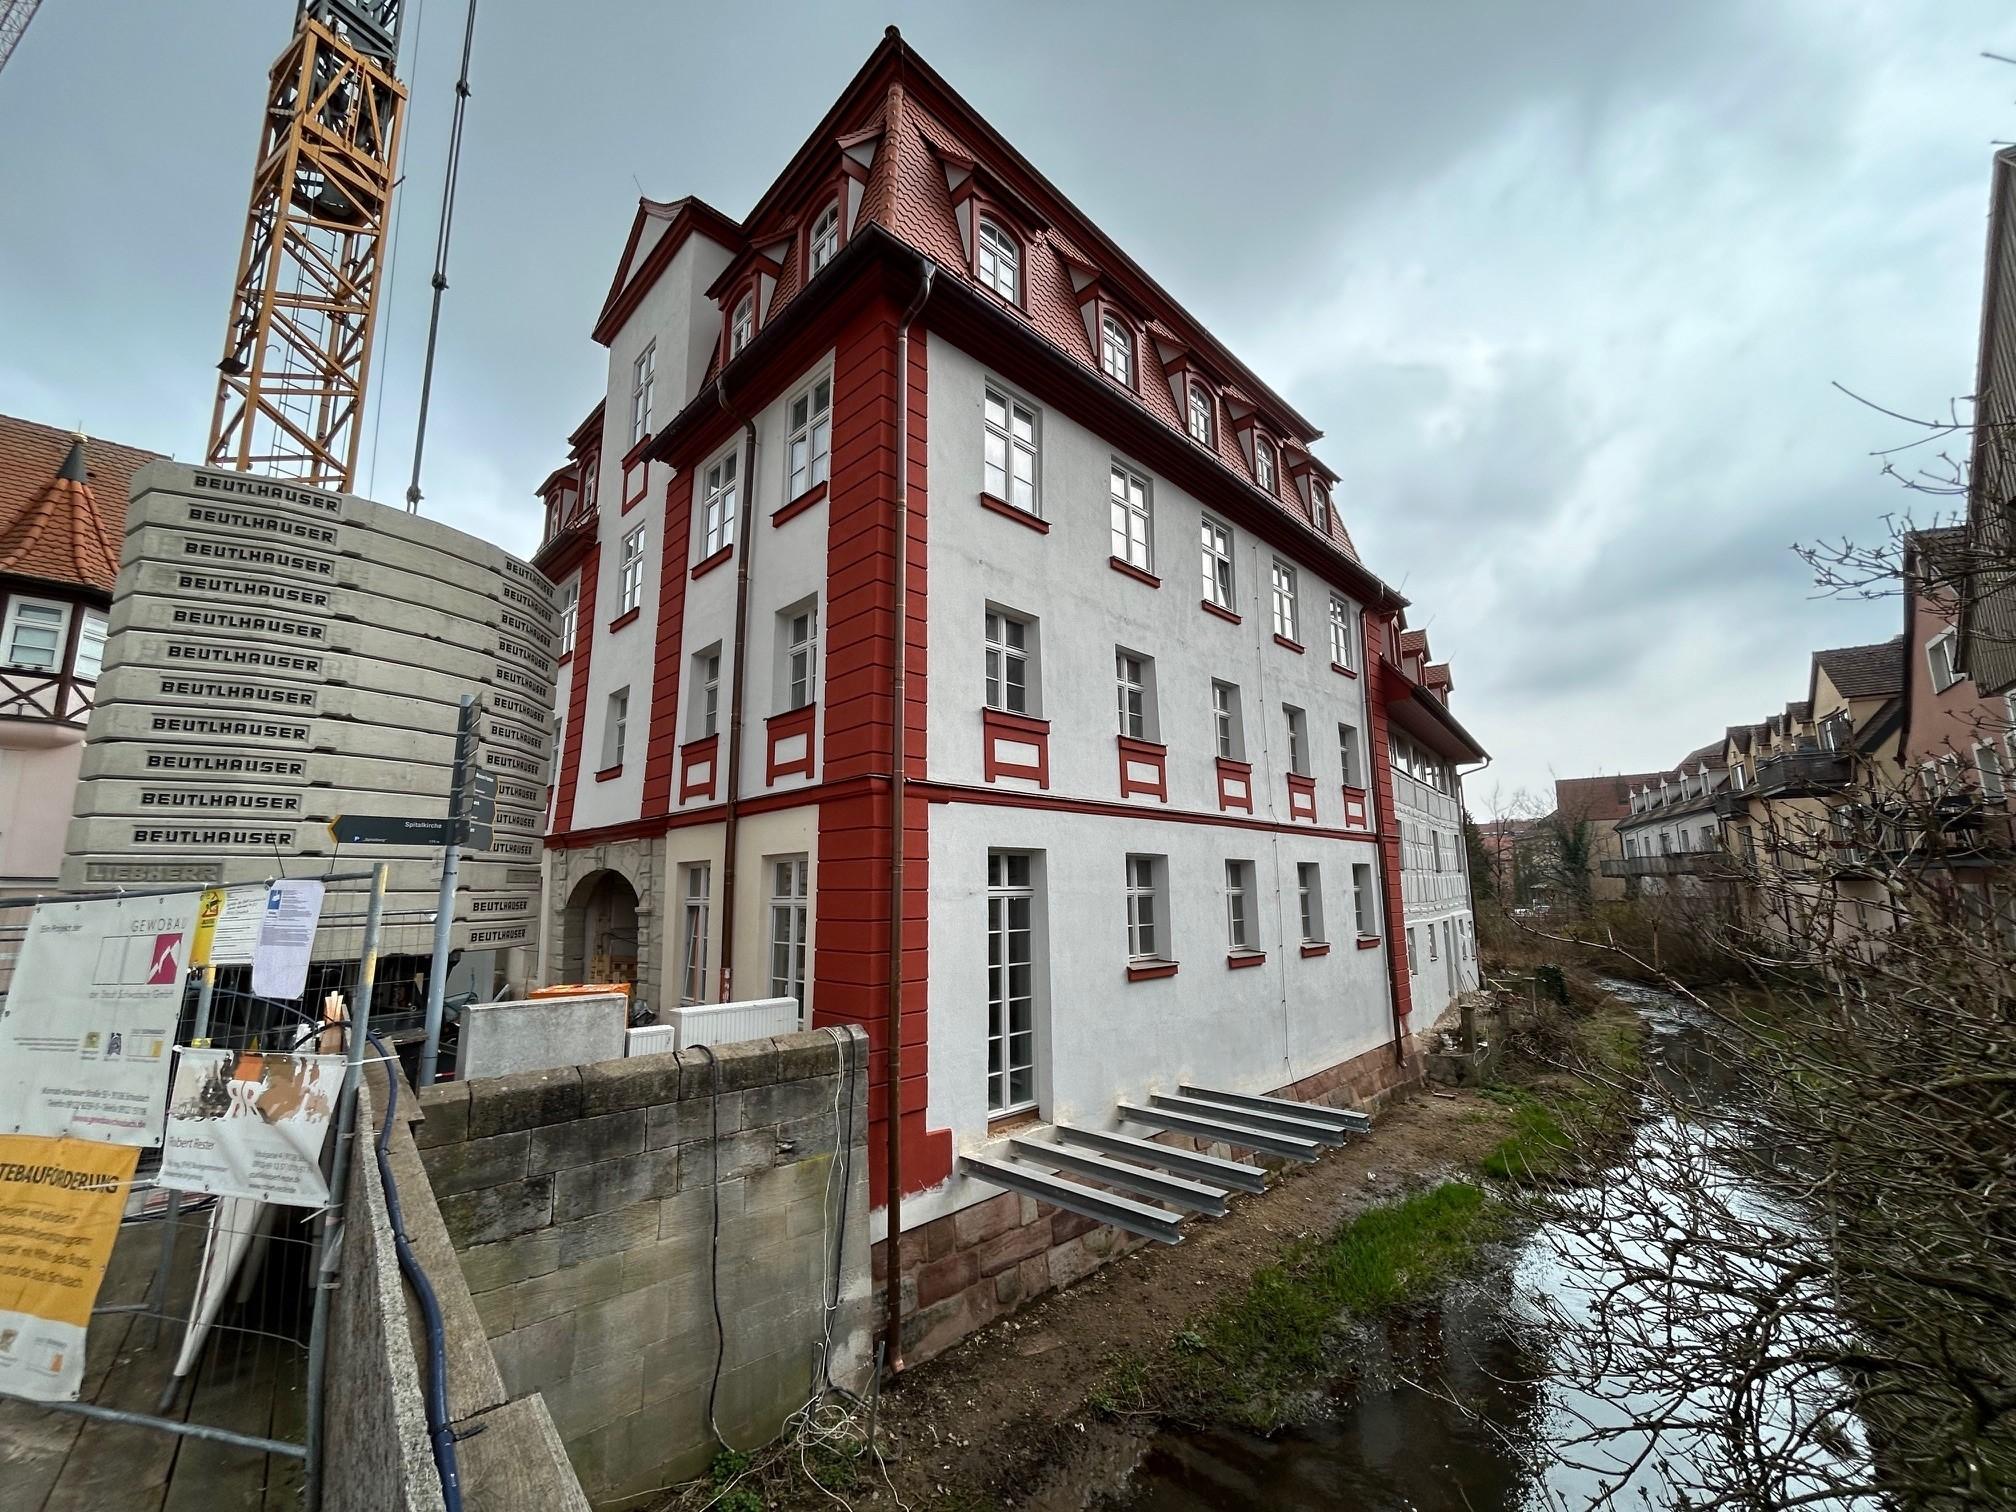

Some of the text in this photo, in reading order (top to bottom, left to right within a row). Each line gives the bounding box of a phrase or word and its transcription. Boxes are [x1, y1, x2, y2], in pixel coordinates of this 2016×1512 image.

[195, 474, 338, 512] BEUTLHAUSER
[189, 508, 334, 544] BEUTLHAUSER
[185, 542, 331, 575] BEUTLHAUSER
[179, 576, 327, 606] BEUTLHAUSER
[173, 610, 322, 639] BEUTLHAUSER
[501, 614, 550, 648] BEUTLHAUSER
[168, 645, 318, 672] BEUTLHAUSER
[499, 641, 549, 672] BEUTLHAUSER
[161, 681, 313, 705] BEUTLHAUSER
[496, 669, 547, 698] BEUTLHAUSER
[494, 698, 544, 723] BEUTLHAUSER
[153, 718, 306, 740] BEUTLHAUSER
[491, 726, 542, 749] BEUTLHAUSER
[147, 755, 302, 775] BEUTLHAUSER
[487, 754, 539, 775] BEUTLHAUSER
[141, 792, 297, 810] BEUTLHAUSER
[499, 785, 536, 800] UTLHAUSER
[404, 821, 442, 829] Spitalkirche
[496, 814, 534, 828] UTLHAUSER
[134, 830, 291, 845] BEUTLHAUSER
[493, 843, 532, 855] UTLHAUSER
[88, 865, 218, 881] LIEBHERR
[472, 901, 528, 911] BEUTLHAUSER
[132, 918, 188, 932] GEWOBAU
[471, 928, 526, 942] BEUTLHAUSER
